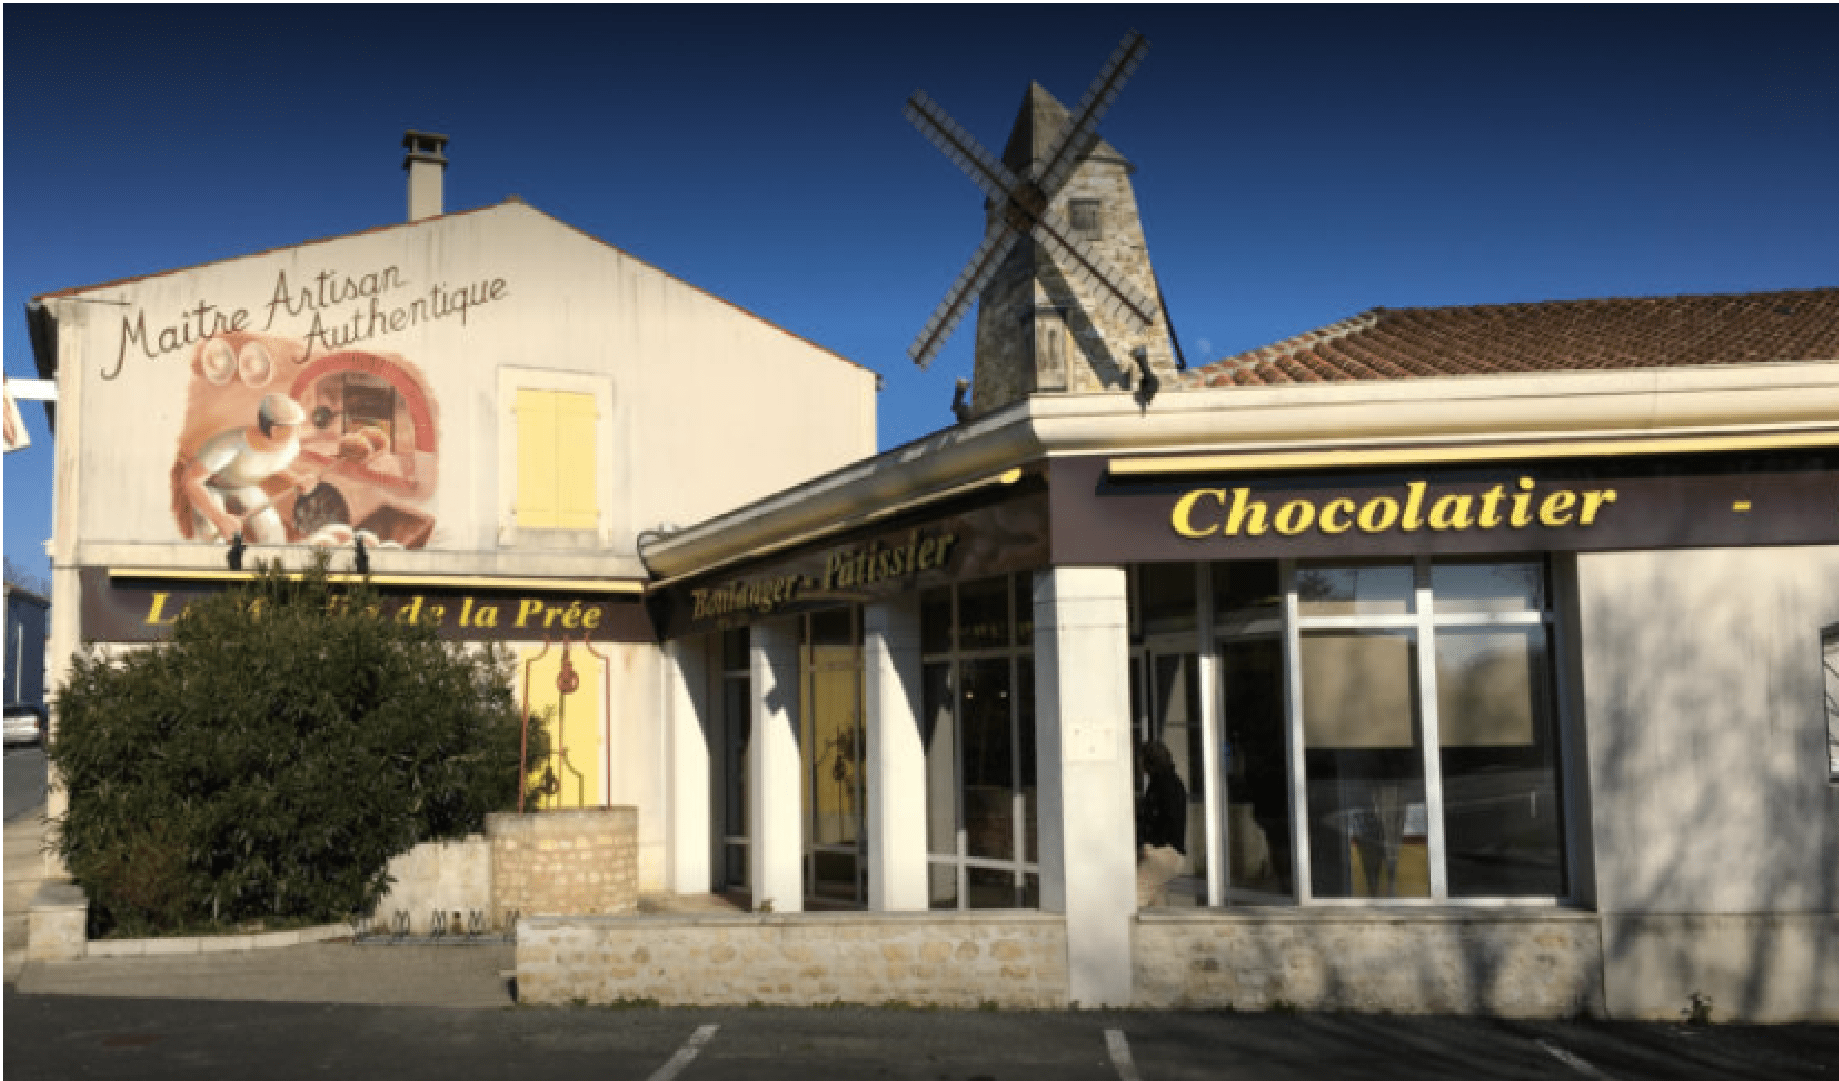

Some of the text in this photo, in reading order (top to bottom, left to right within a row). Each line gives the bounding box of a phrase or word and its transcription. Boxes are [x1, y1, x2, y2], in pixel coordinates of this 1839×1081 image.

[265, 264, 408, 332] Artisan
[292, 277, 508, 364] Authentique
[1171, 476, 1618, 539] Chocolatier
[458, 595, 499, 628] la
[511, 597, 602, 629] Prée
